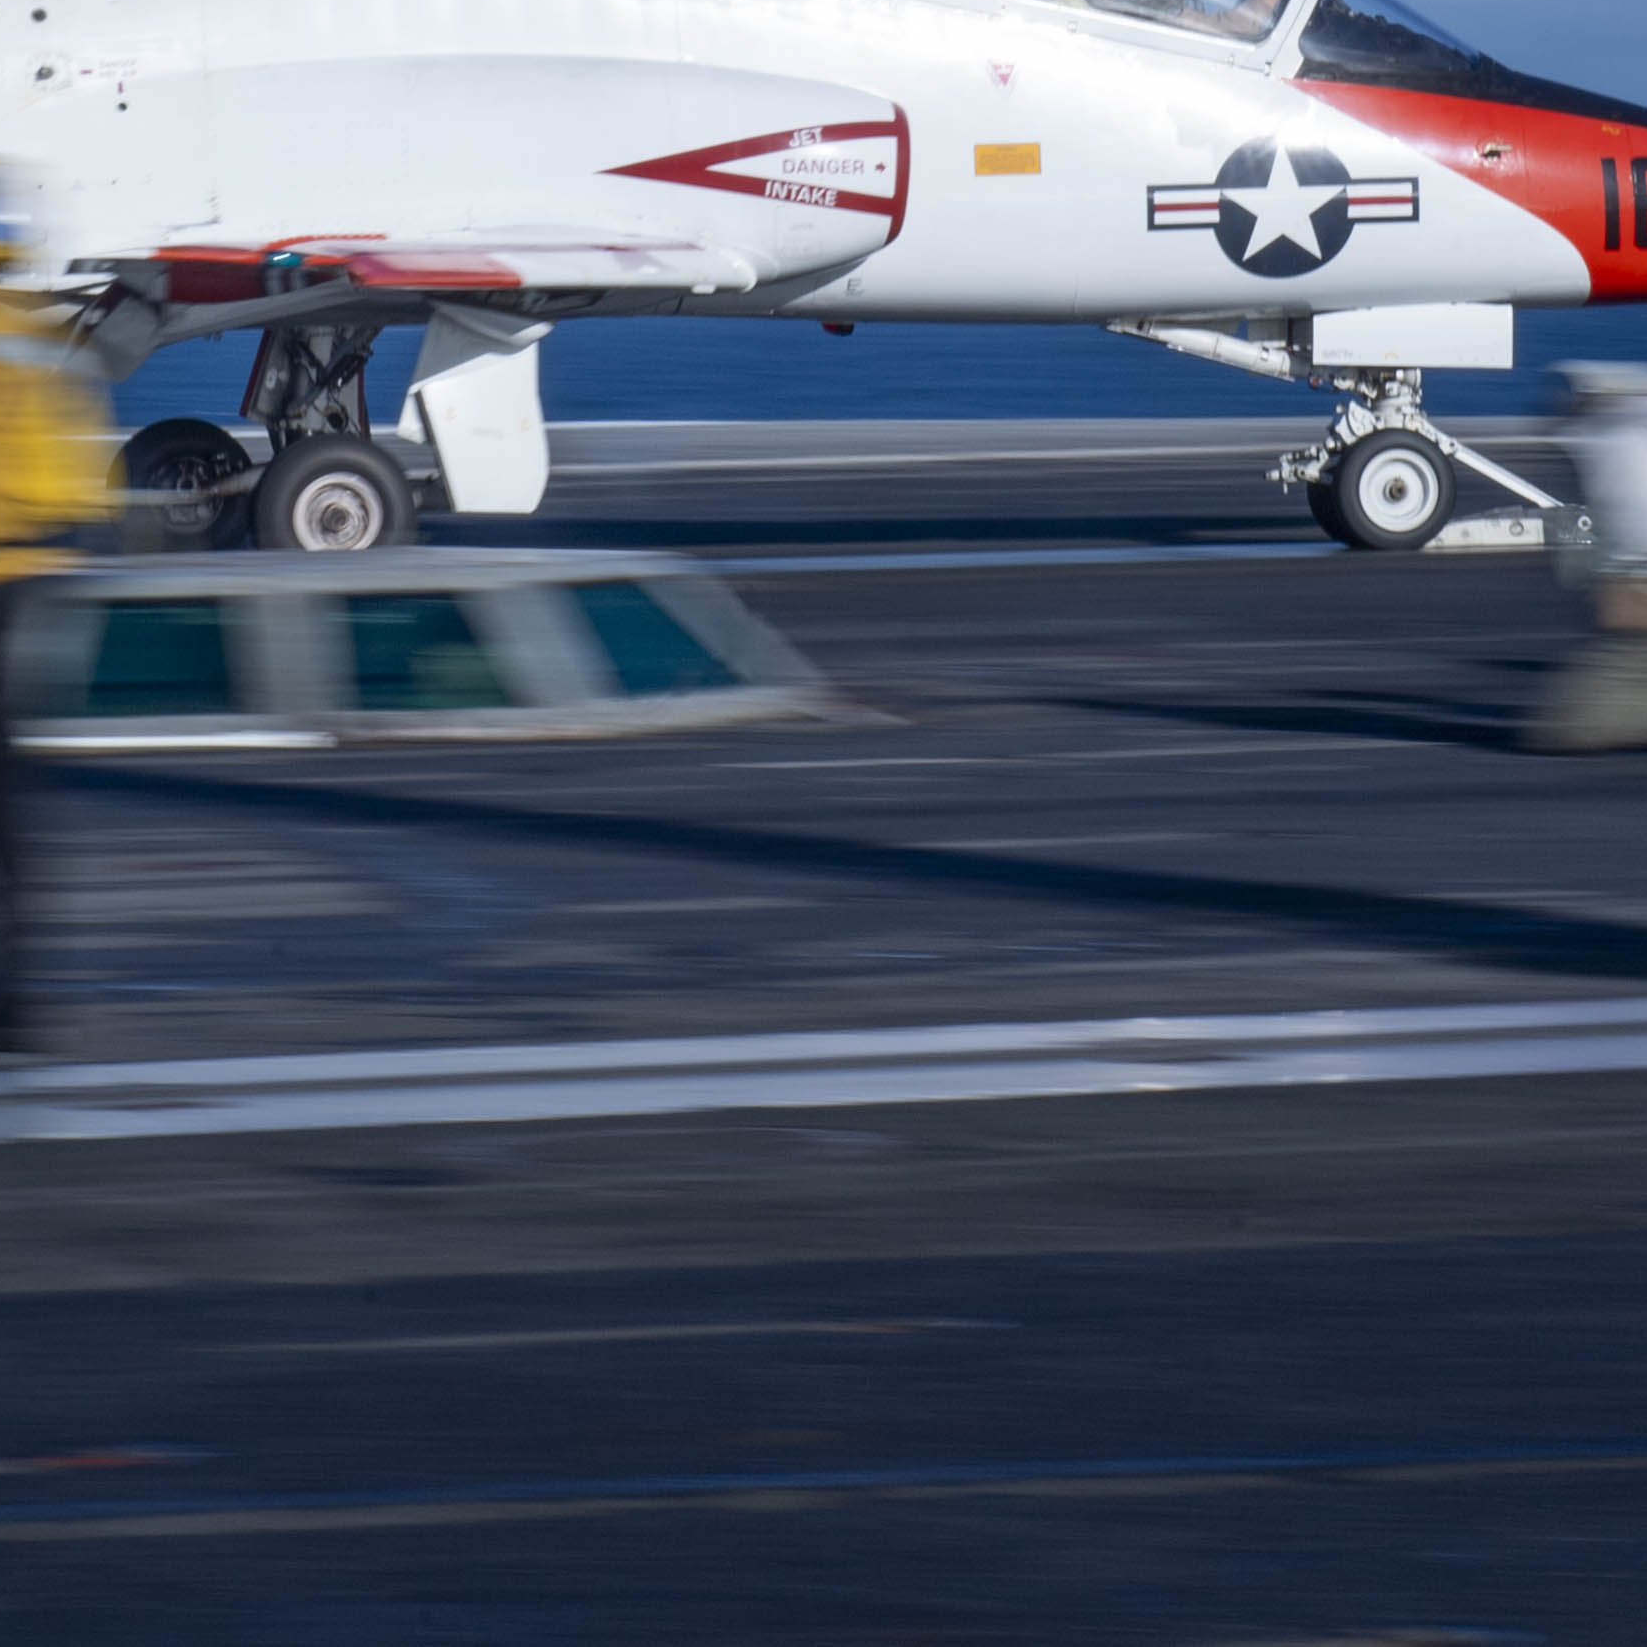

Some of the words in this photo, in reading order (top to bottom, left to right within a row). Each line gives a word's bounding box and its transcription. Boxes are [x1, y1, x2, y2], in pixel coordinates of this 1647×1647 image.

[789, 126, 823, 147] JET
[782, 158, 865, 174] DANGER
[764, 179, 838, 207] INTAKE
